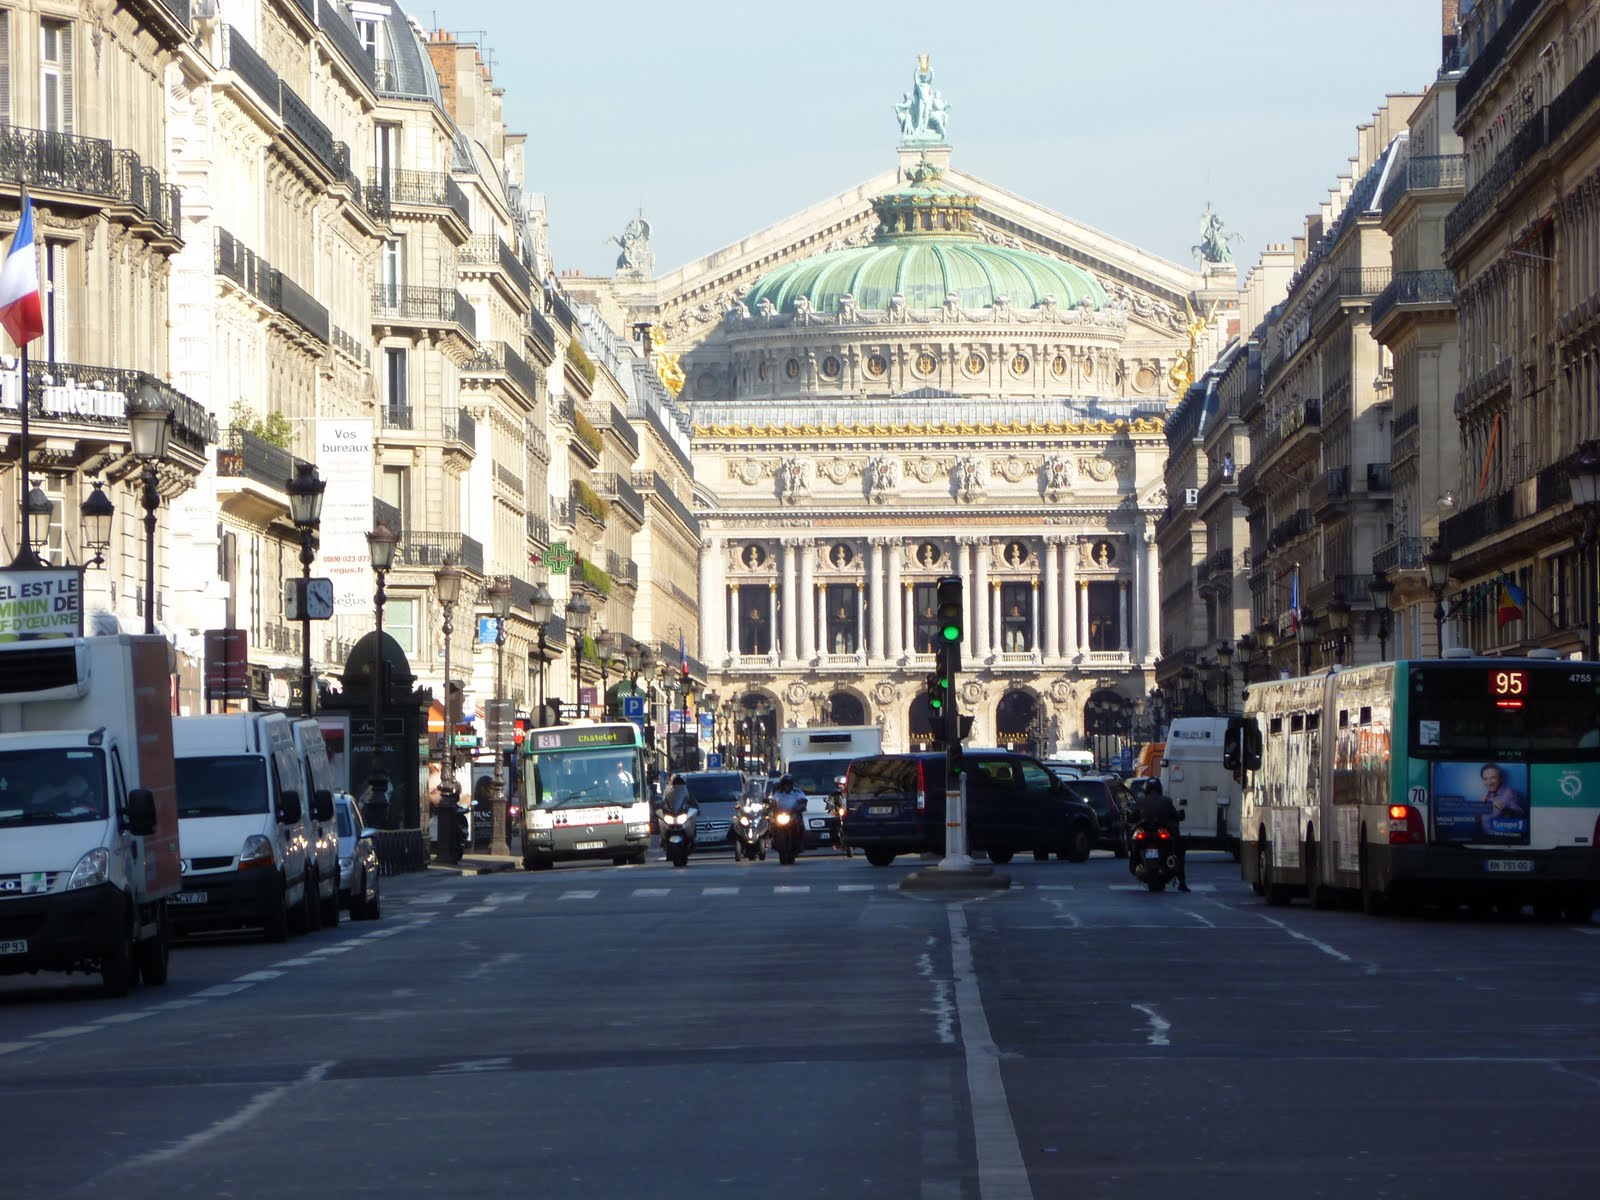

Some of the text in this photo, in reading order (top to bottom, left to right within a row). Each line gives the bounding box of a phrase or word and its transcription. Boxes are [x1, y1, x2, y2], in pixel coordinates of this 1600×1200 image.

[335, 428, 357, 439] Vos
[322, 443, 369, 453] bureaux
[1185, 488, 1200, 504] B
[330, 566, 365, 575] regus.fr
[21, 580, 53, 597] EST
[58, 578, 78, 593] LE
[54, 595, 78, 612] DE
[1496, 672, 1522, 694] 95
[1569, 674, 1592, 683] 4755
[629, 700, 639, 713] P
[542, 735, 558, 747] 81
[1412, 788, 1425, 803] 70
[12, 941, 25, 952] 93
